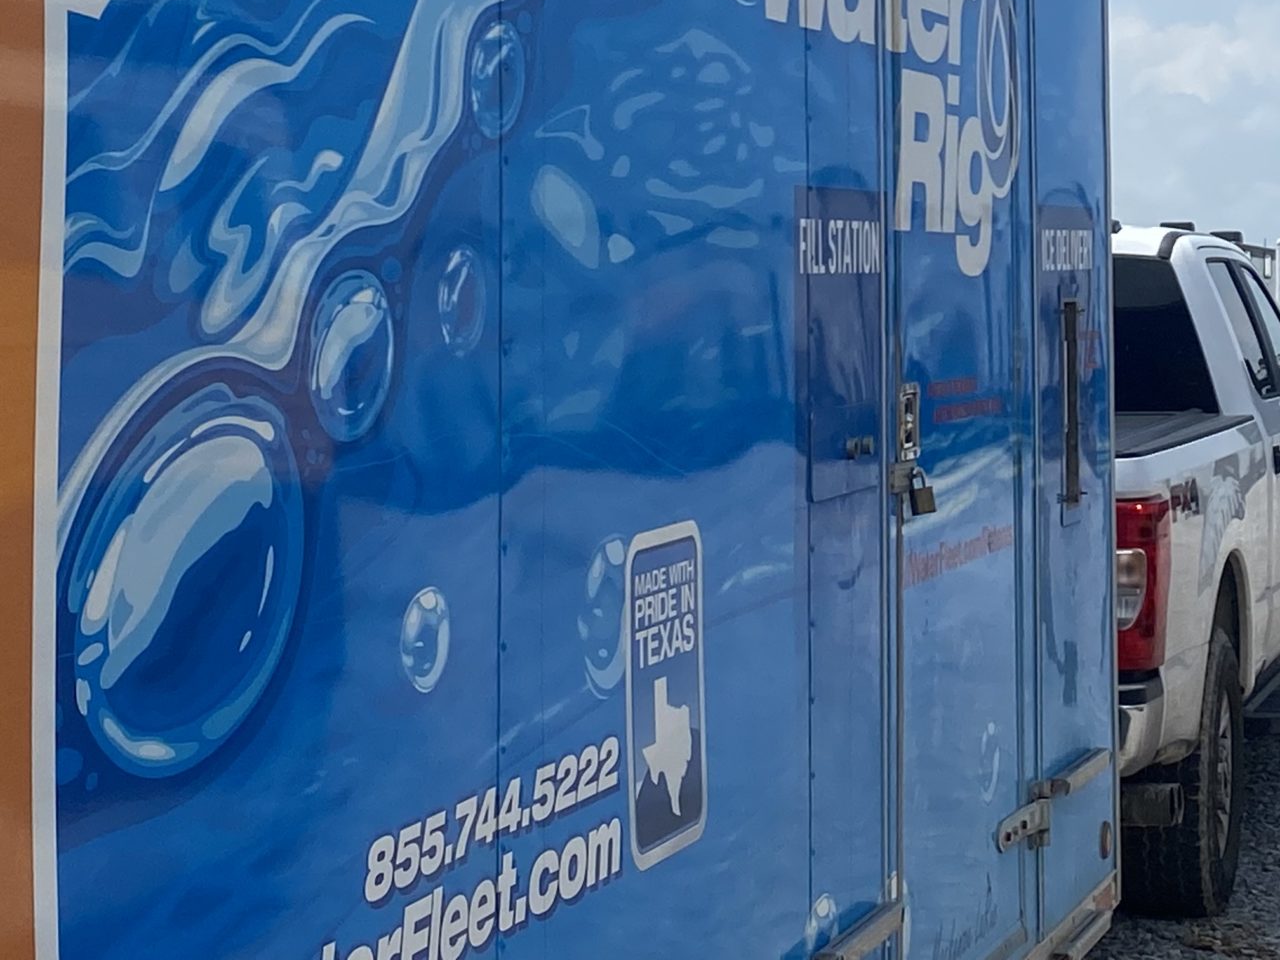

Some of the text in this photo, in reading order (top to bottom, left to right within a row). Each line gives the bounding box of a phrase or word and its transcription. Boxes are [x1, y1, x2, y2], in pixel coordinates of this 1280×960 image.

[895, 68, 993, 278] Rig
[800, 218, 881, 274] FILL STATION
[634, 559, 695, 597] MADE WITH
[635, 582, 695, 629] PRIDE IN
[635, 613, 695, 669] TEXAS
[364, 736, 620, 903] 855.744.5222
